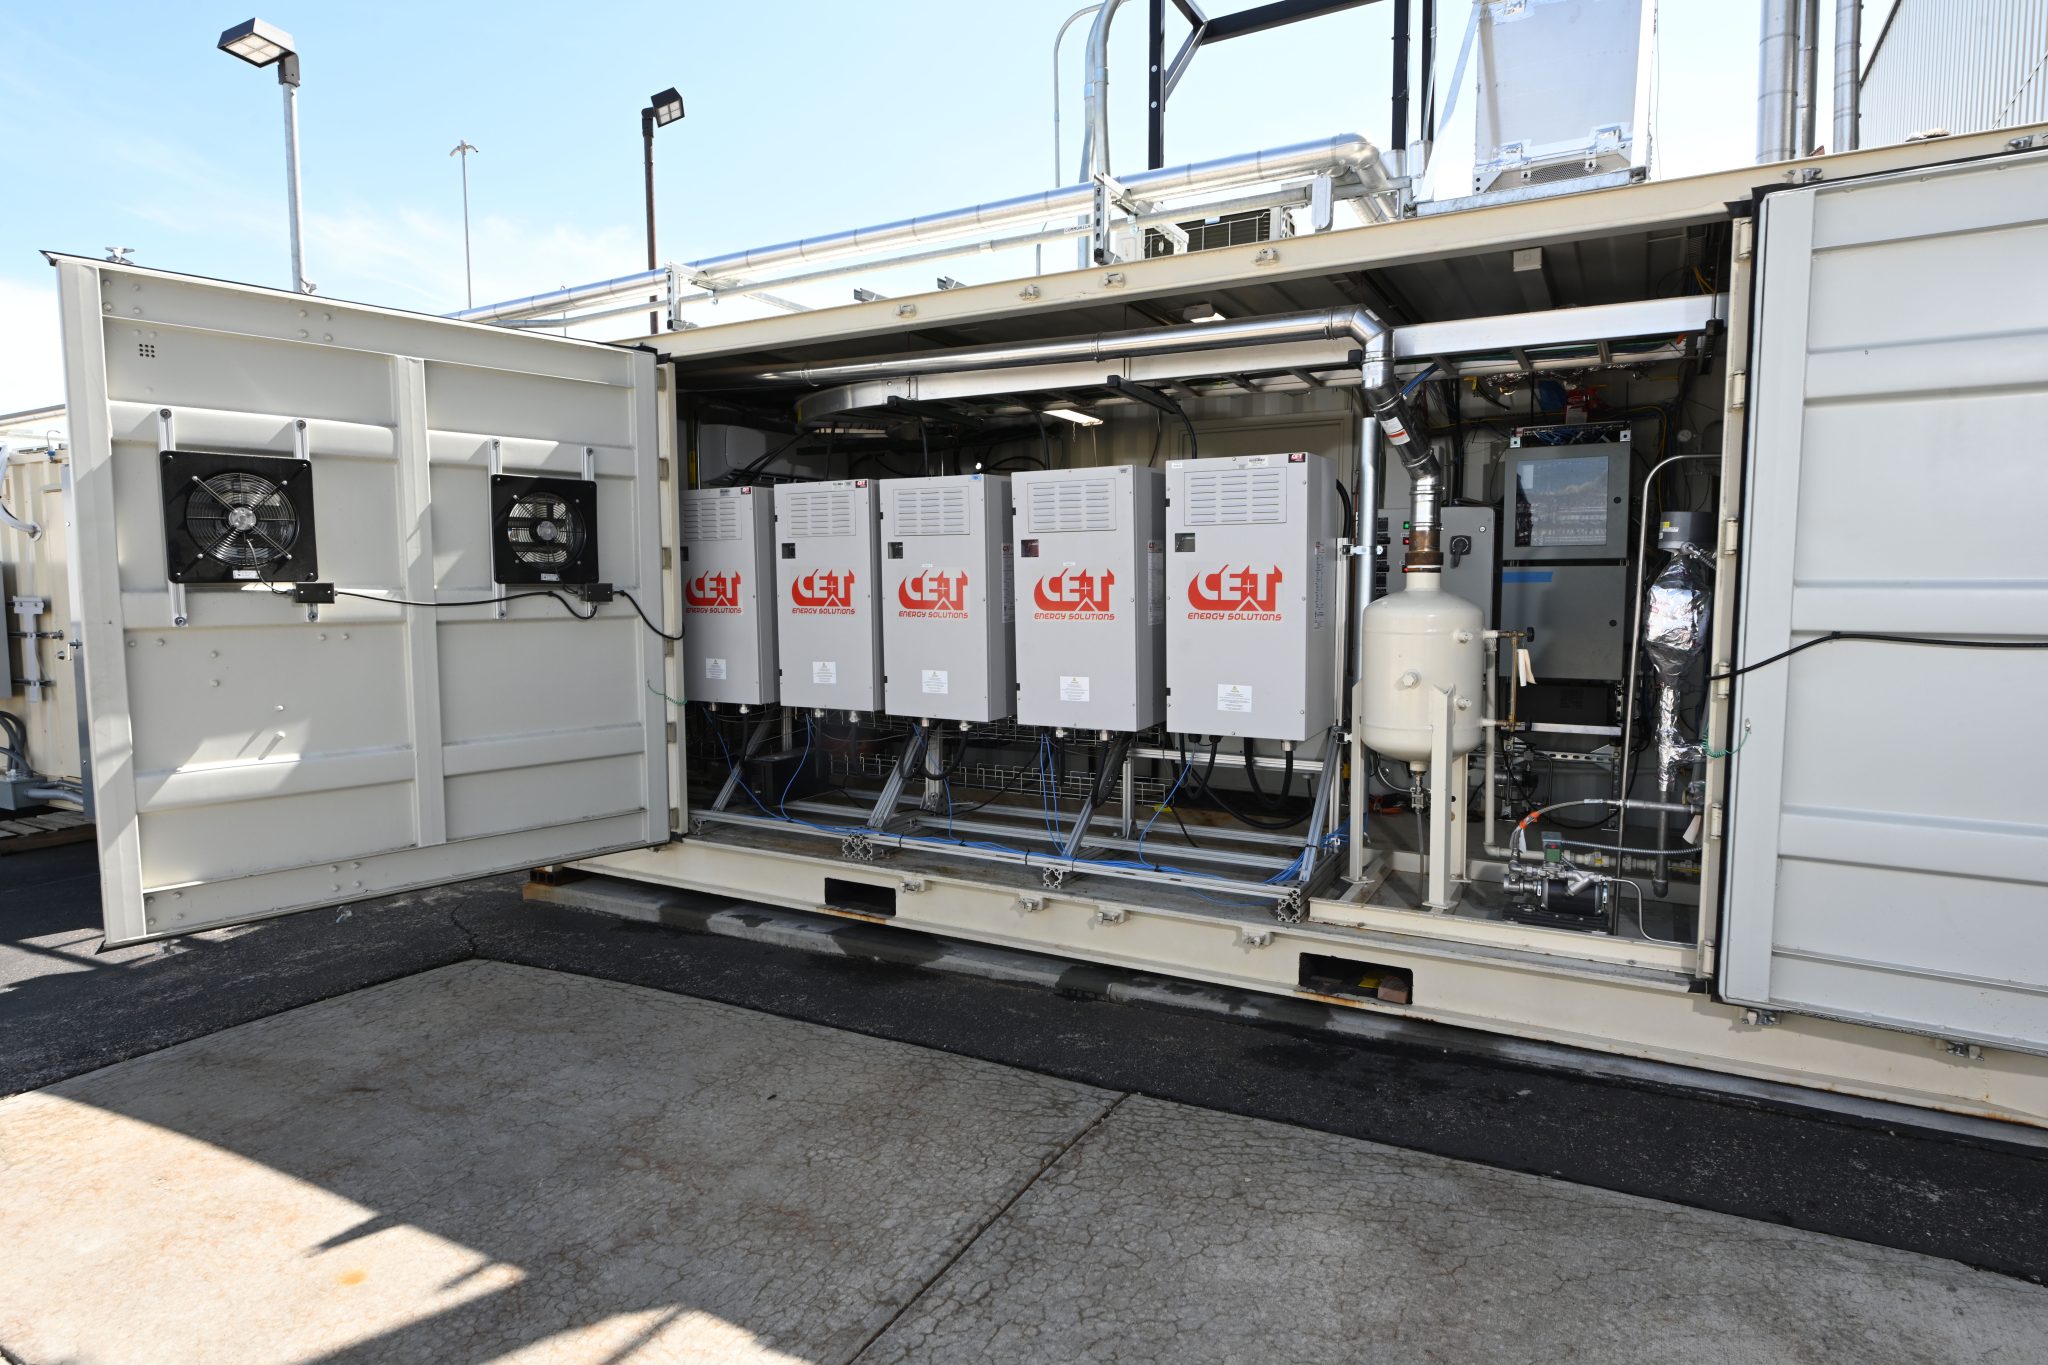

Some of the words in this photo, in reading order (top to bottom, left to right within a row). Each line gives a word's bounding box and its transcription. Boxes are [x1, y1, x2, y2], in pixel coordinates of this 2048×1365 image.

[898, 610, 927, 618] ENERGY
[927, 611, 969, 619] SOLUTIONS
[1034, 612, 1067, 620] ENERGY
[1068, 613, 1115, 621] SOLUTIONS
[1187, 612, 1225, 620] ENERGY
[1227, 613, 1282, 621] SOLUTIONS
